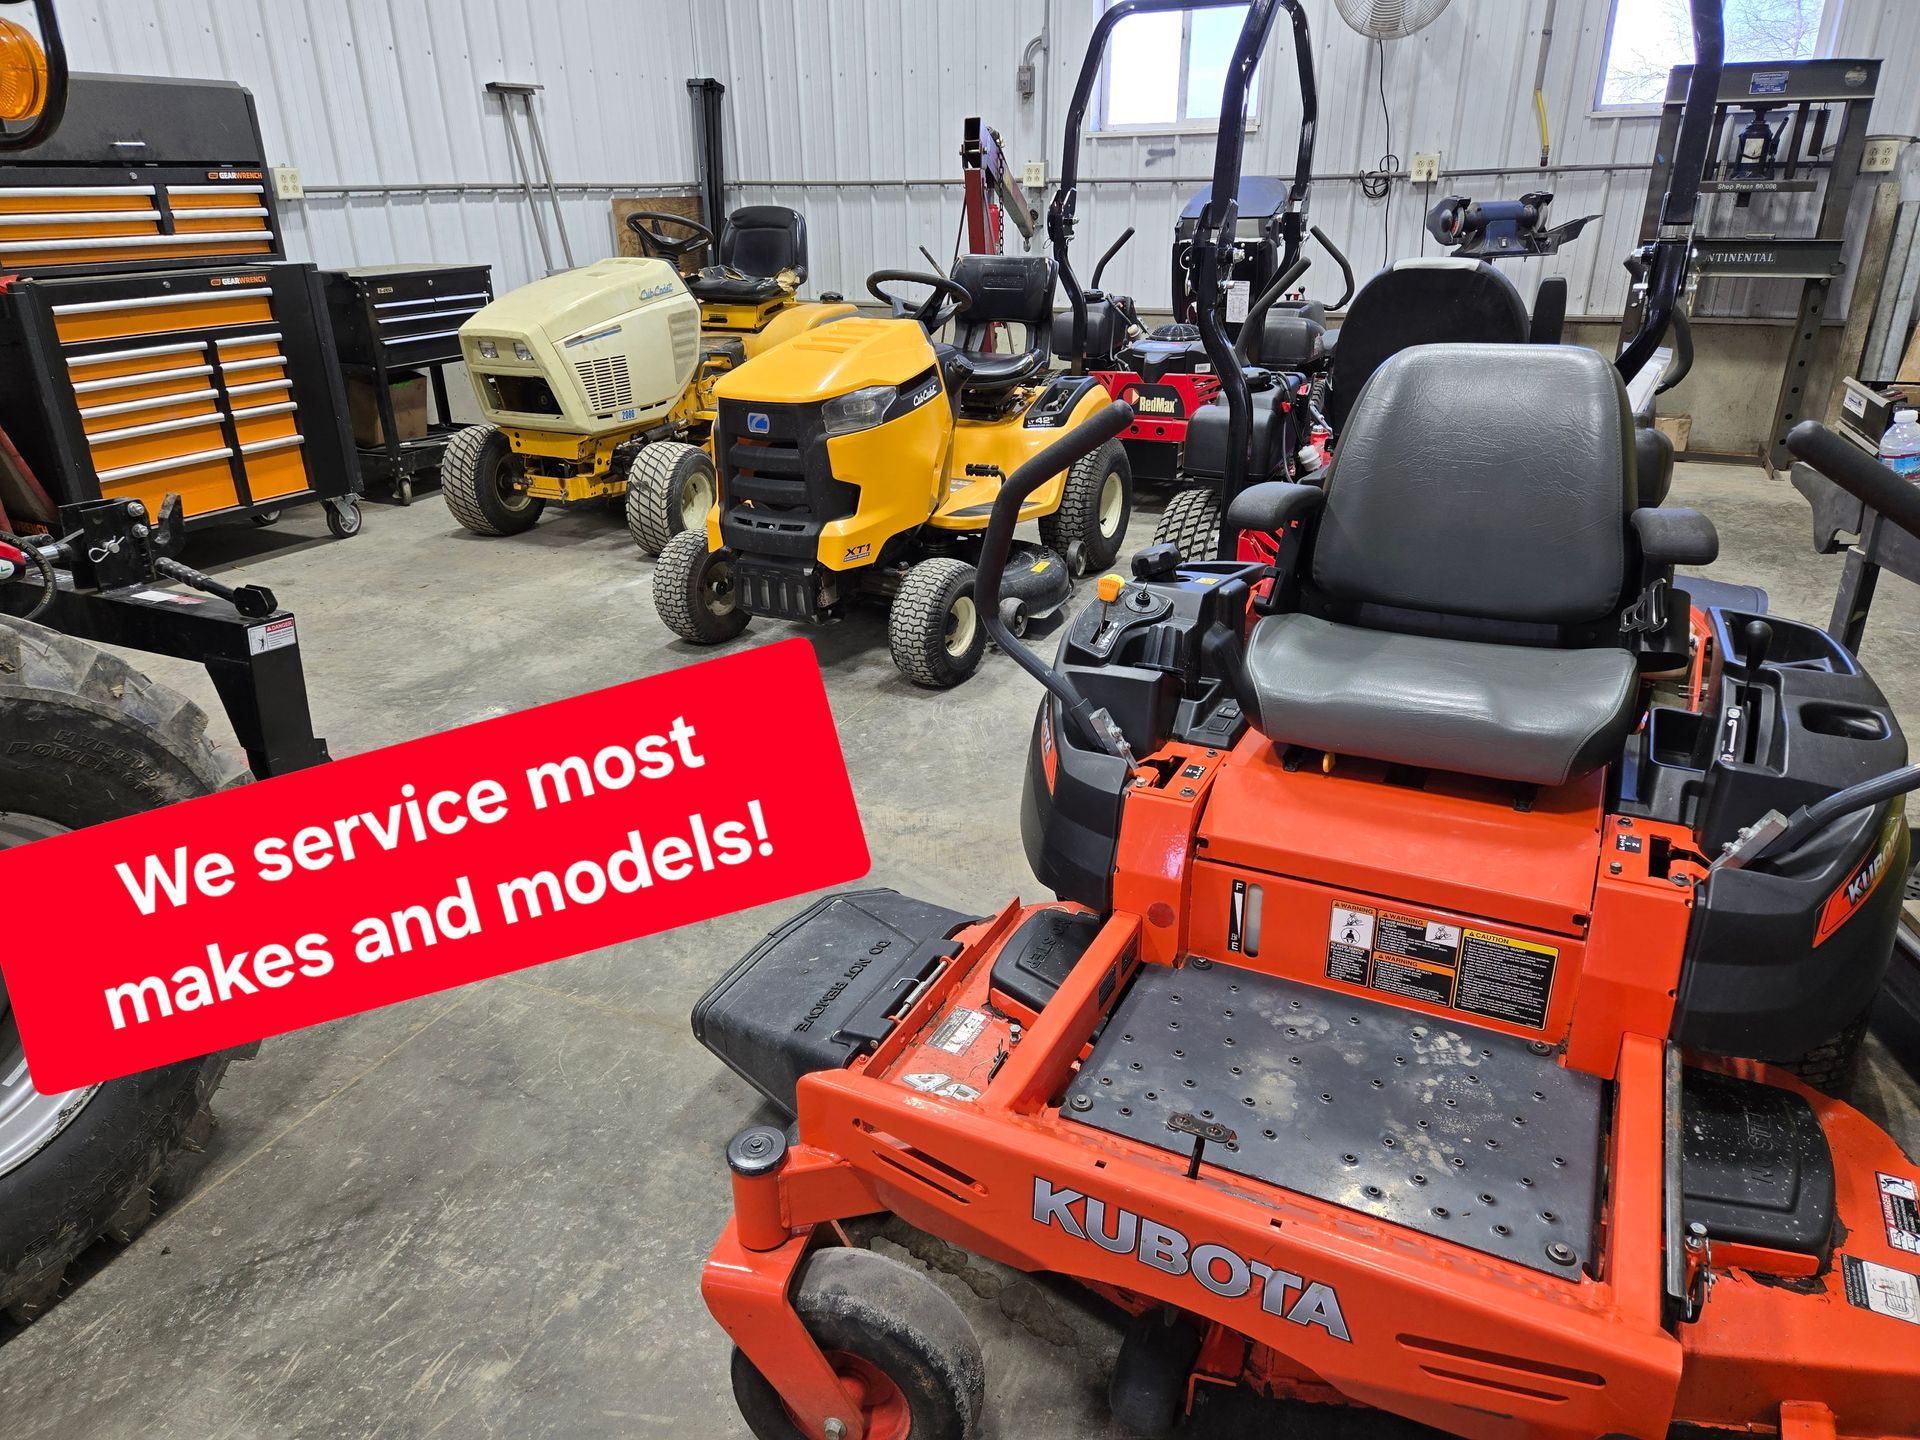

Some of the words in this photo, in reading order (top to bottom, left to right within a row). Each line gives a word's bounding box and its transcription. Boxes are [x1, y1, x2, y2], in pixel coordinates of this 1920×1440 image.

[219, 171, 263, 180] GEARWRENCH
[1705, 252, 1775, 262] NTINENTAL
[222, 275, 267, 285] GEARWRENCH
[845, 543, 871, 557] XT1
[271, 620, 293, 631] DANGER
[1235, 882, 1243, 891] F
[1340, 903, 1374, 915] WARNING
[1389, 913, 1424, 926] WARNING
[1475, 932, 1510, 945] CAUTION
[868, 940, 892, 956] DO
[1231, 941, 1239, 951] E
[1384, 954, 1418, 968] WARNING
[843, 958, 872, 981] NOT
[793, 981, 849, 1033] REMOVE
[1033, 1176, 1353, 1343] KUBOTA
